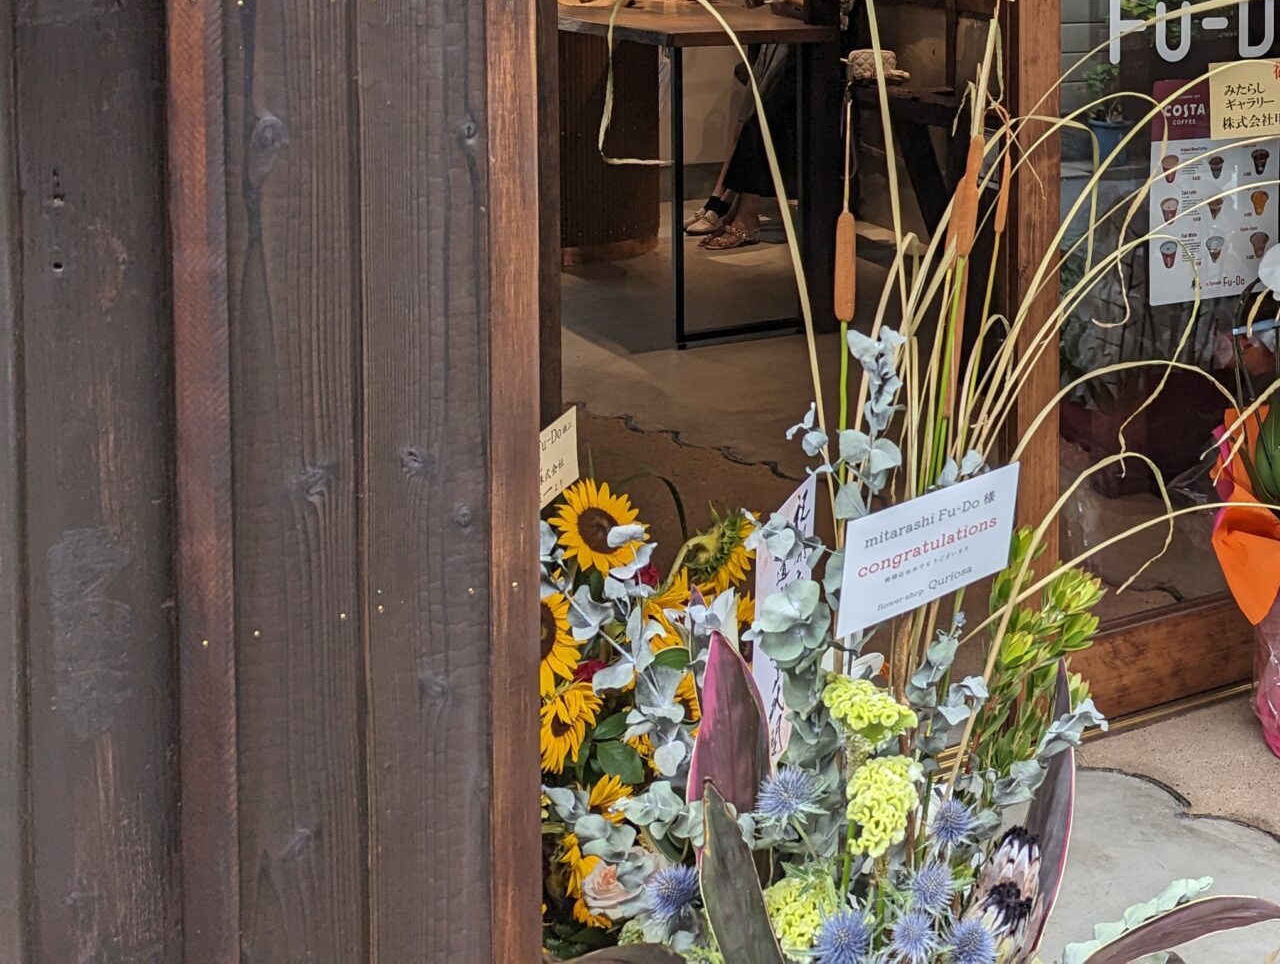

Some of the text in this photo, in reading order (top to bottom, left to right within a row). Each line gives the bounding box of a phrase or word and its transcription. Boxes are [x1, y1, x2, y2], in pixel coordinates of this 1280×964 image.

[1223, 82, 1265, 96] みたらし
[1164, 103, 1206, 117] COSTA
[1226, 96, 1274, 111] ギャラリー
[1223, 276, 1245, 287] Fu-Do
[540, 429, 562, 451] u-Do
[863, 490, 996, 549] mitarashi Fu-Do 様
[857, 516, 998, 578] congratulations
[877, 565, 973, 612] flower shop Quriosa
